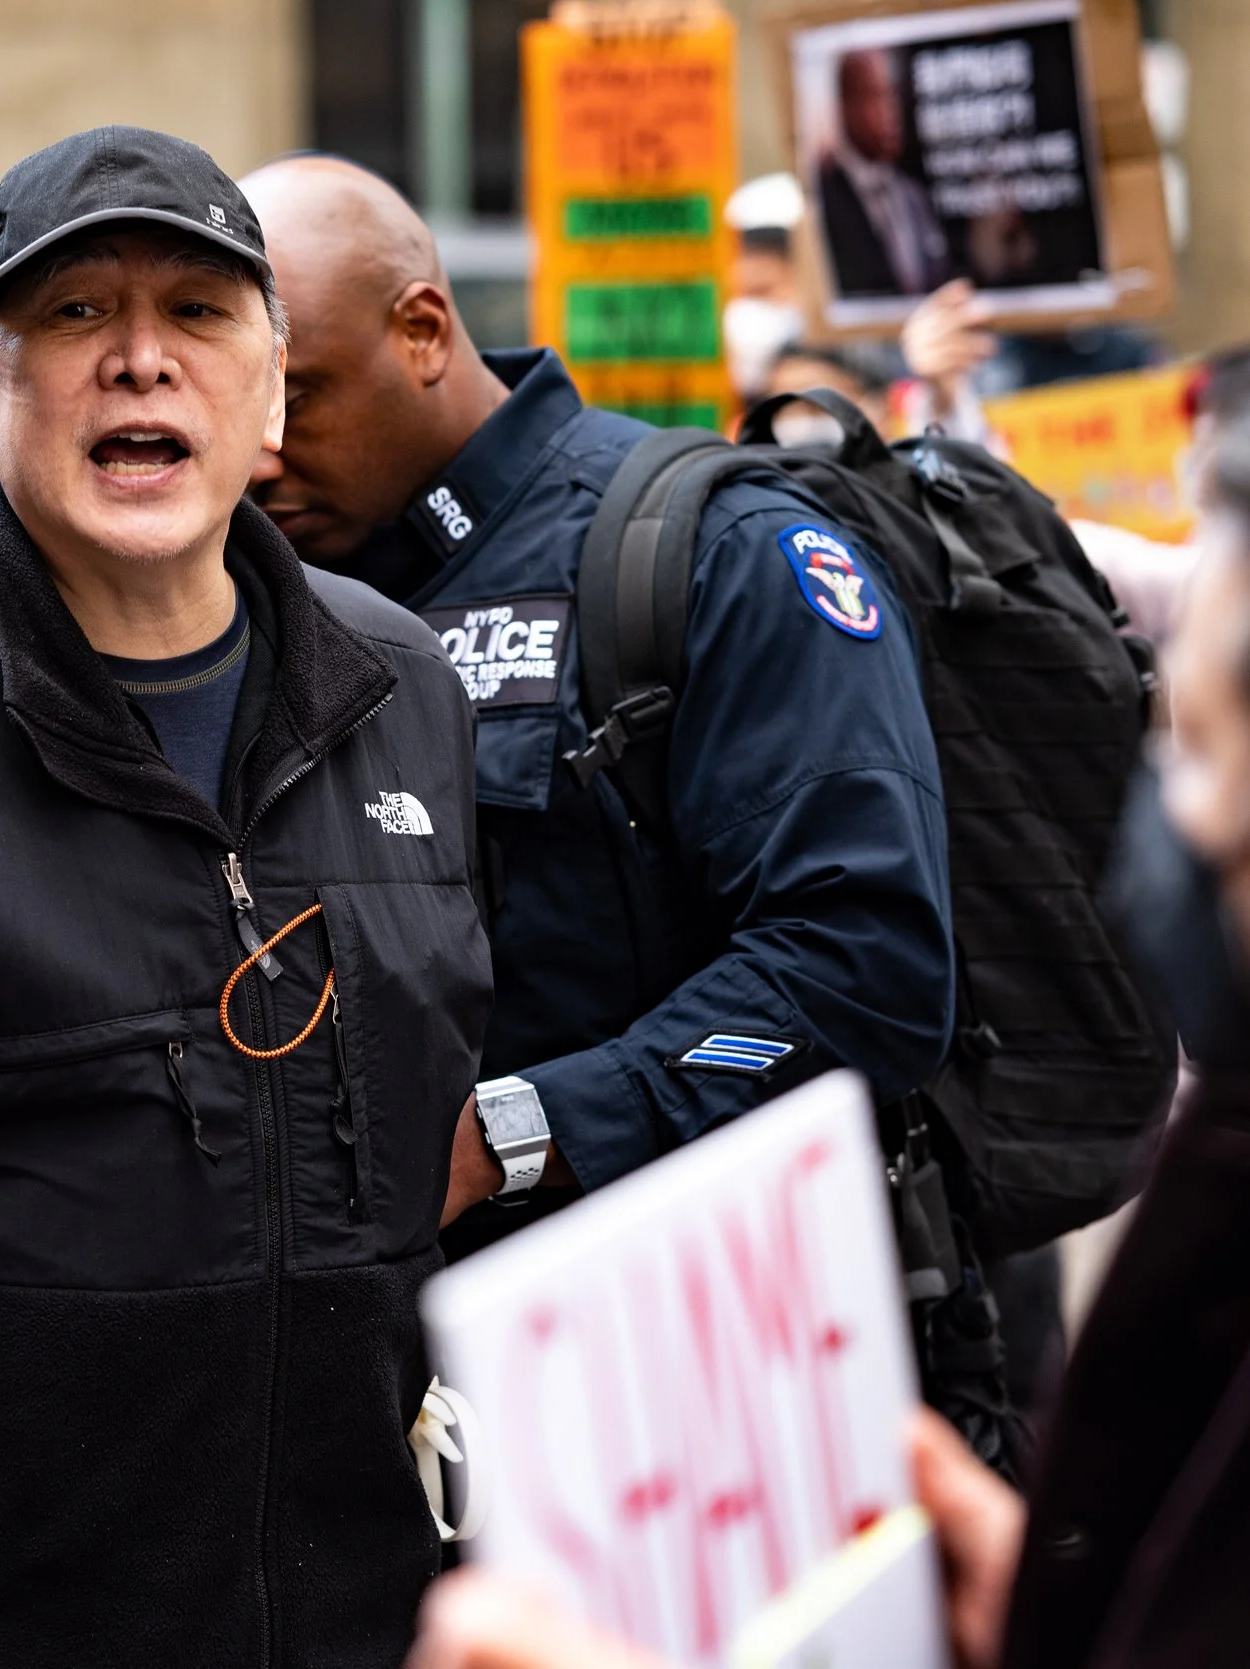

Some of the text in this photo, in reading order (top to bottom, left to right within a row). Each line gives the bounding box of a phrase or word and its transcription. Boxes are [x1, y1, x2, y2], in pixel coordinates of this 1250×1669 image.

[427, 487, 472, 540] SRG
[464, 606, 513, 628] NYPD
[434, 620, 559, 665] OLICE
[477, 660, 557, 682] RESPONSE
[462, 680, 501, 701] OUP
[379, 791, 403, 807] THE
[364, 803, 407, 820] NORTH
[381, 819, 412, 835] FACE
